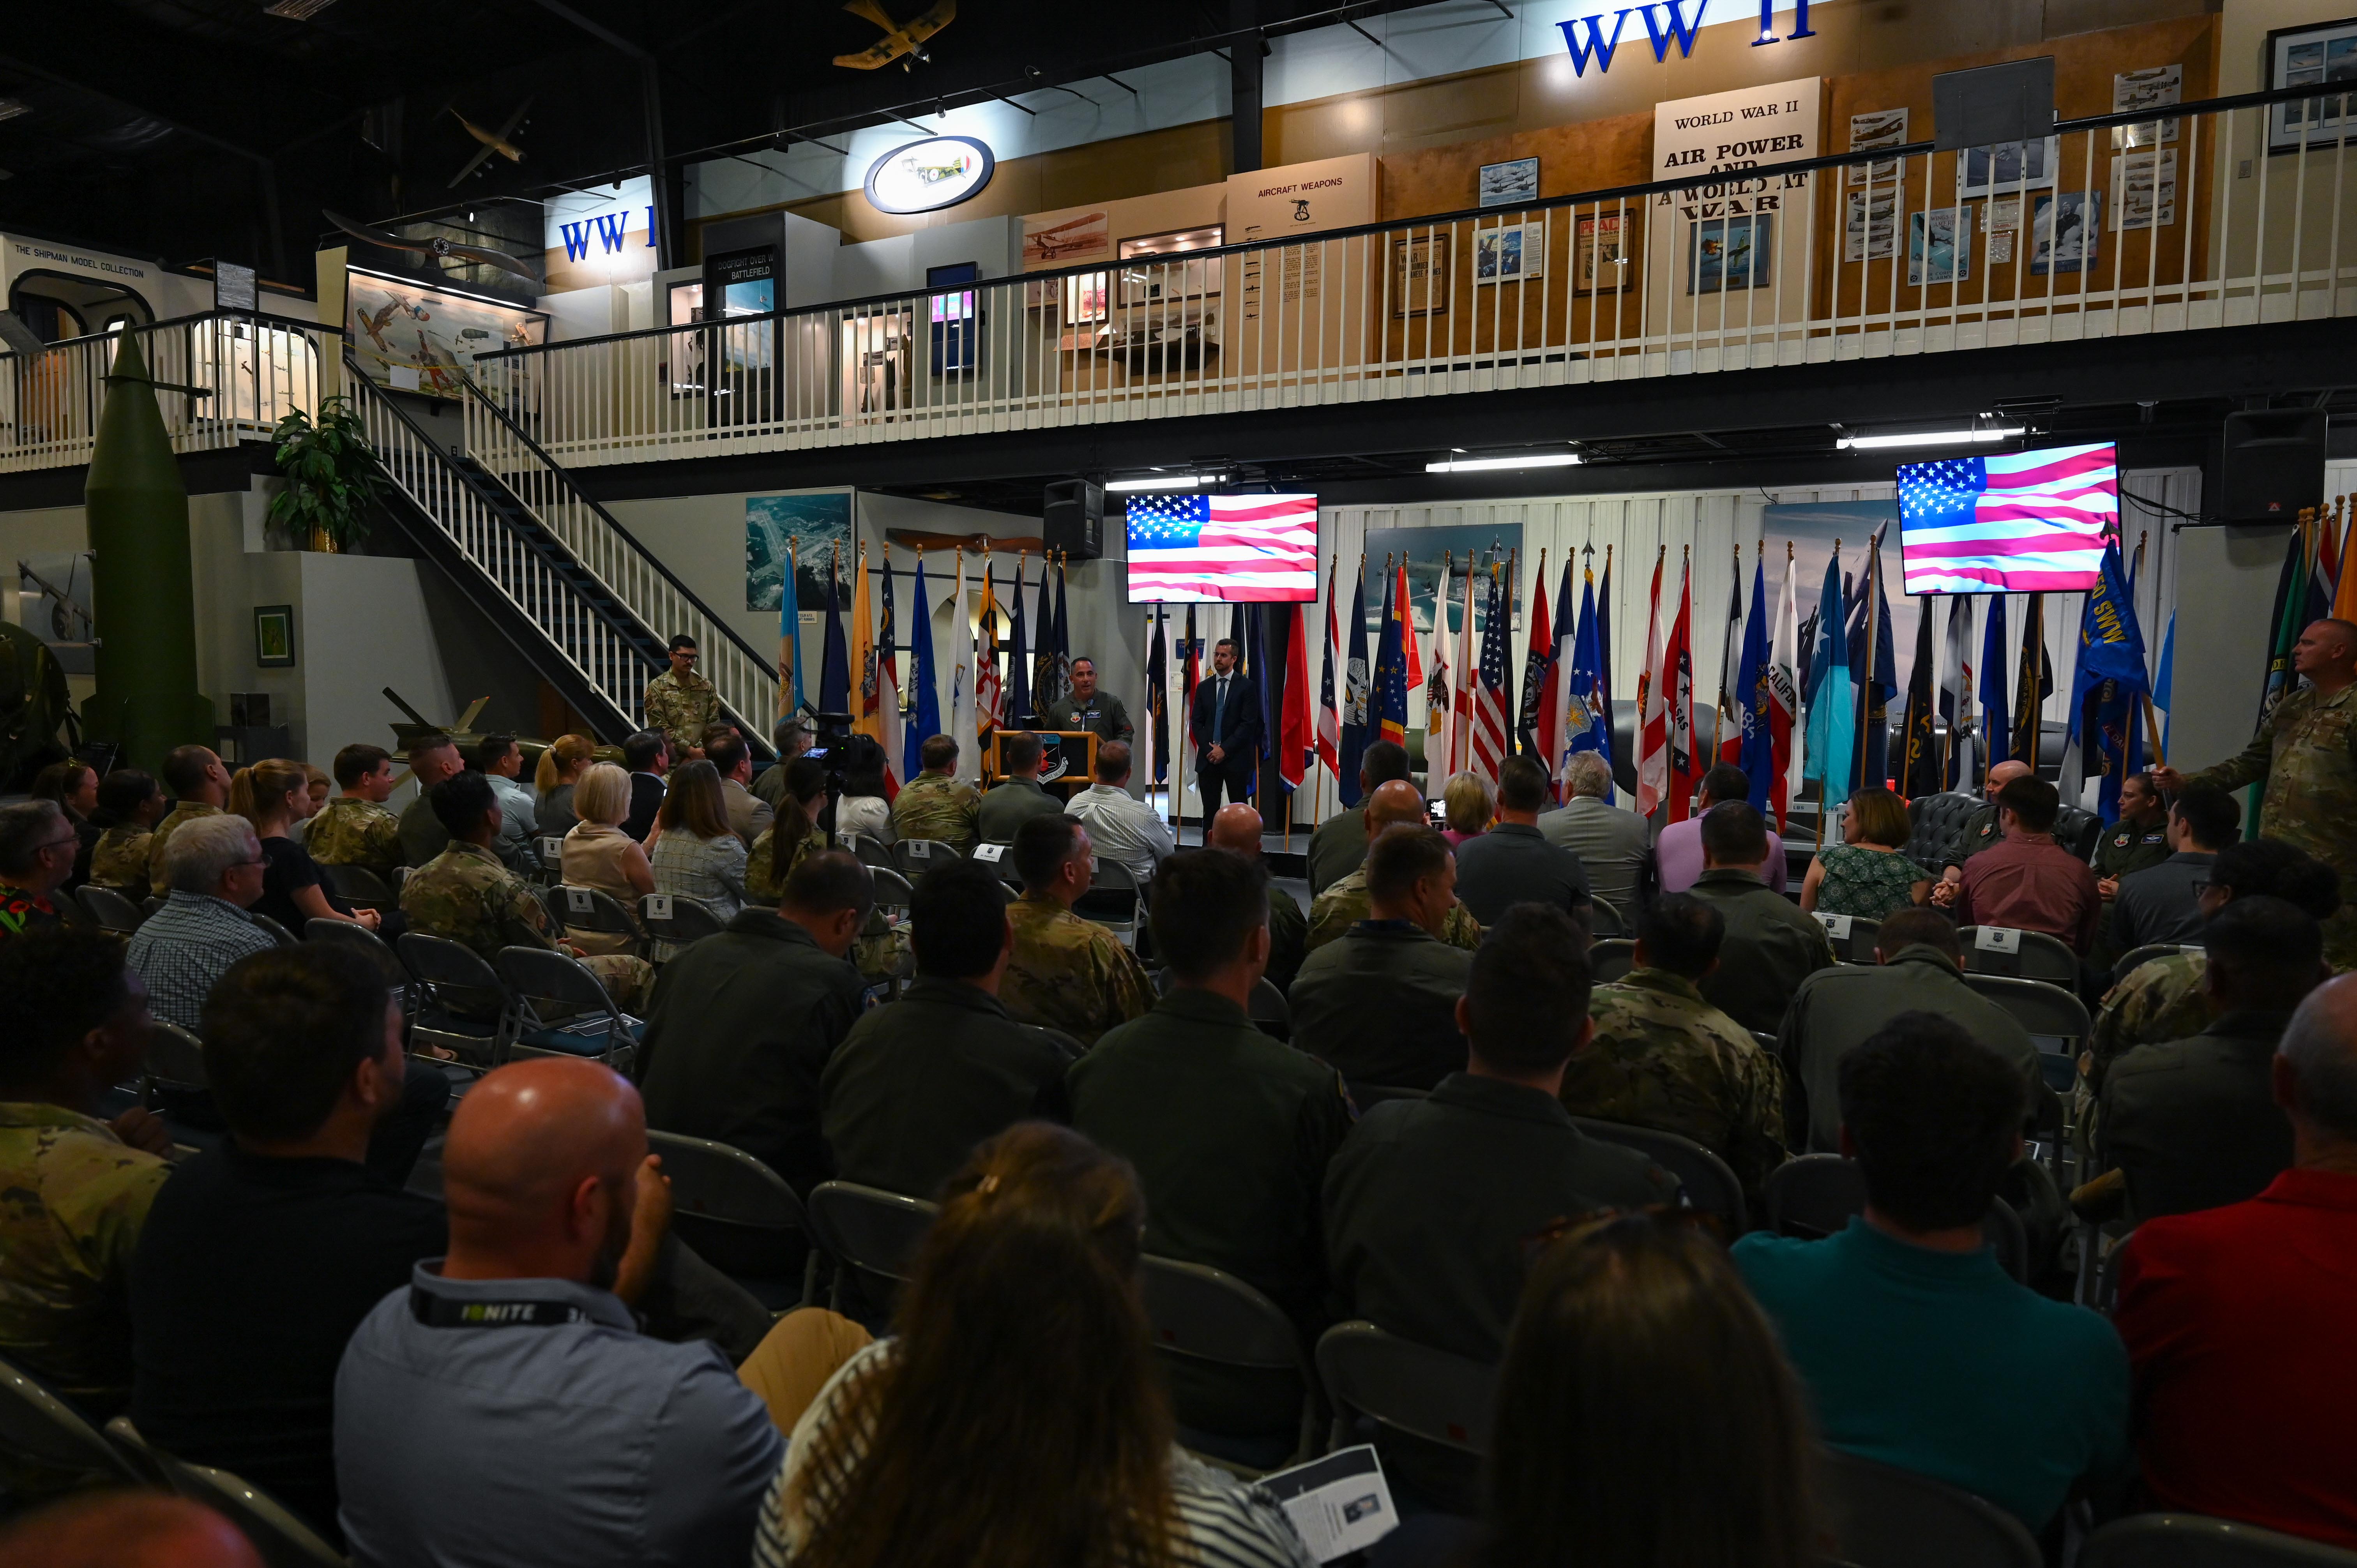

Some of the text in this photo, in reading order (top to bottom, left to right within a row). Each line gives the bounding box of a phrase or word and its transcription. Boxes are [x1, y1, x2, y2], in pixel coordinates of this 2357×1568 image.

[1555, 0, 1816, 78] WW II
[1675, 100, 1799, 130] WORLD WAR II
[1664, 134, 1804, 168] AIR POWER
[1258, 178, 1343, 198] AIRCRAFT WEAPONS
[1657, 172, 1808, 206] A WORLD AT
[1680, 195, 1780, 220] WAR
[559, 211, 629, 263] WW
[1934, 219, 1963, 227] AMERI
[15, 245, 143, 278] THE SHIPMAN MODEL COLLECTION
[718, 258, 748, 270] DOGFIGHT
[750, 255, 766, 265] OVER
[731, 266, 770, 280] BATTLEFIELD
[1403, 268, 1441, 279] JANESE PNES
[2093, 570, 2126, 644] 50 SWW
[1769, 666, 1792, 703] CALIFO
[1053, 763, 1067, 777] MUSEUM
